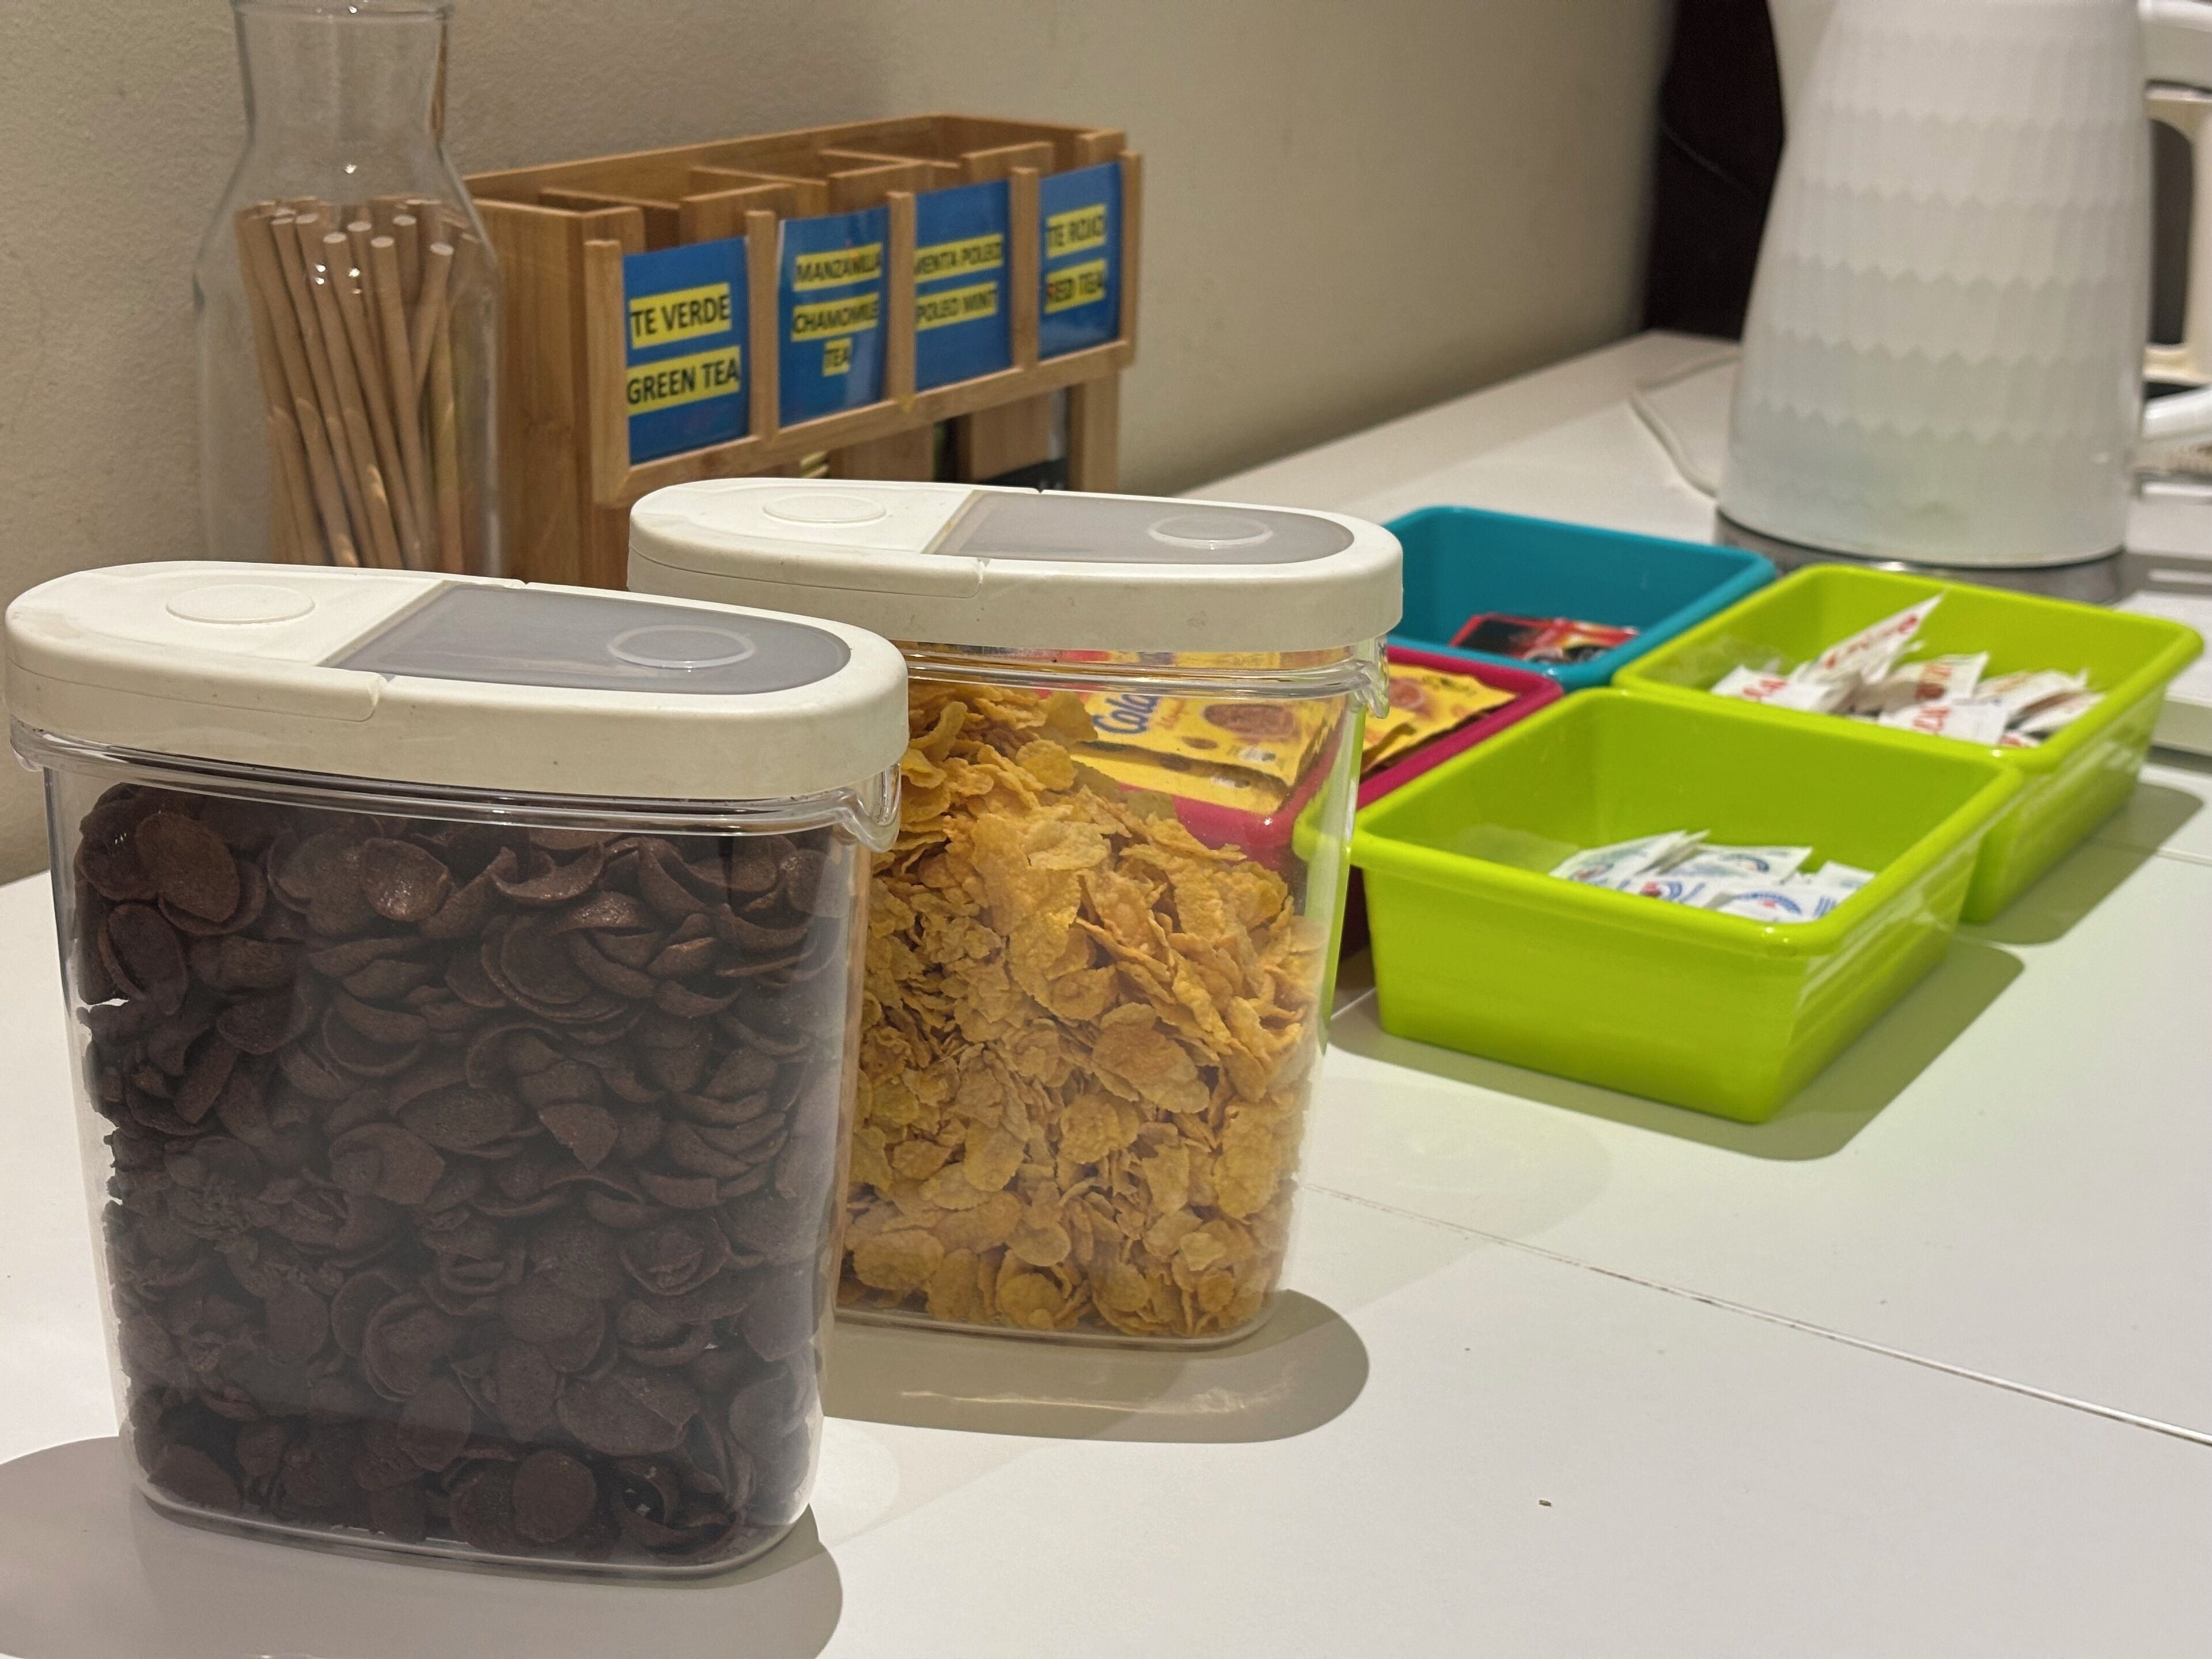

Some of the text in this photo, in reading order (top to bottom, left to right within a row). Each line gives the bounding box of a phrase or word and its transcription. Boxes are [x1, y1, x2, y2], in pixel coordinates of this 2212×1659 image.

[1047, 224, 1065, 248] TE
[795, 253, 881, 282] MANZANILLA
[963, 289, 996, 313] MINT
[1047, 271, 1104, 304] RED TEA
[632, 294, 729, 338] TE VERDE
[792, 298, 878, 334] CHAMOMILE
[824, 346, 850, 369] TEA
[627, 358, 740, 405] GREEN TEA
